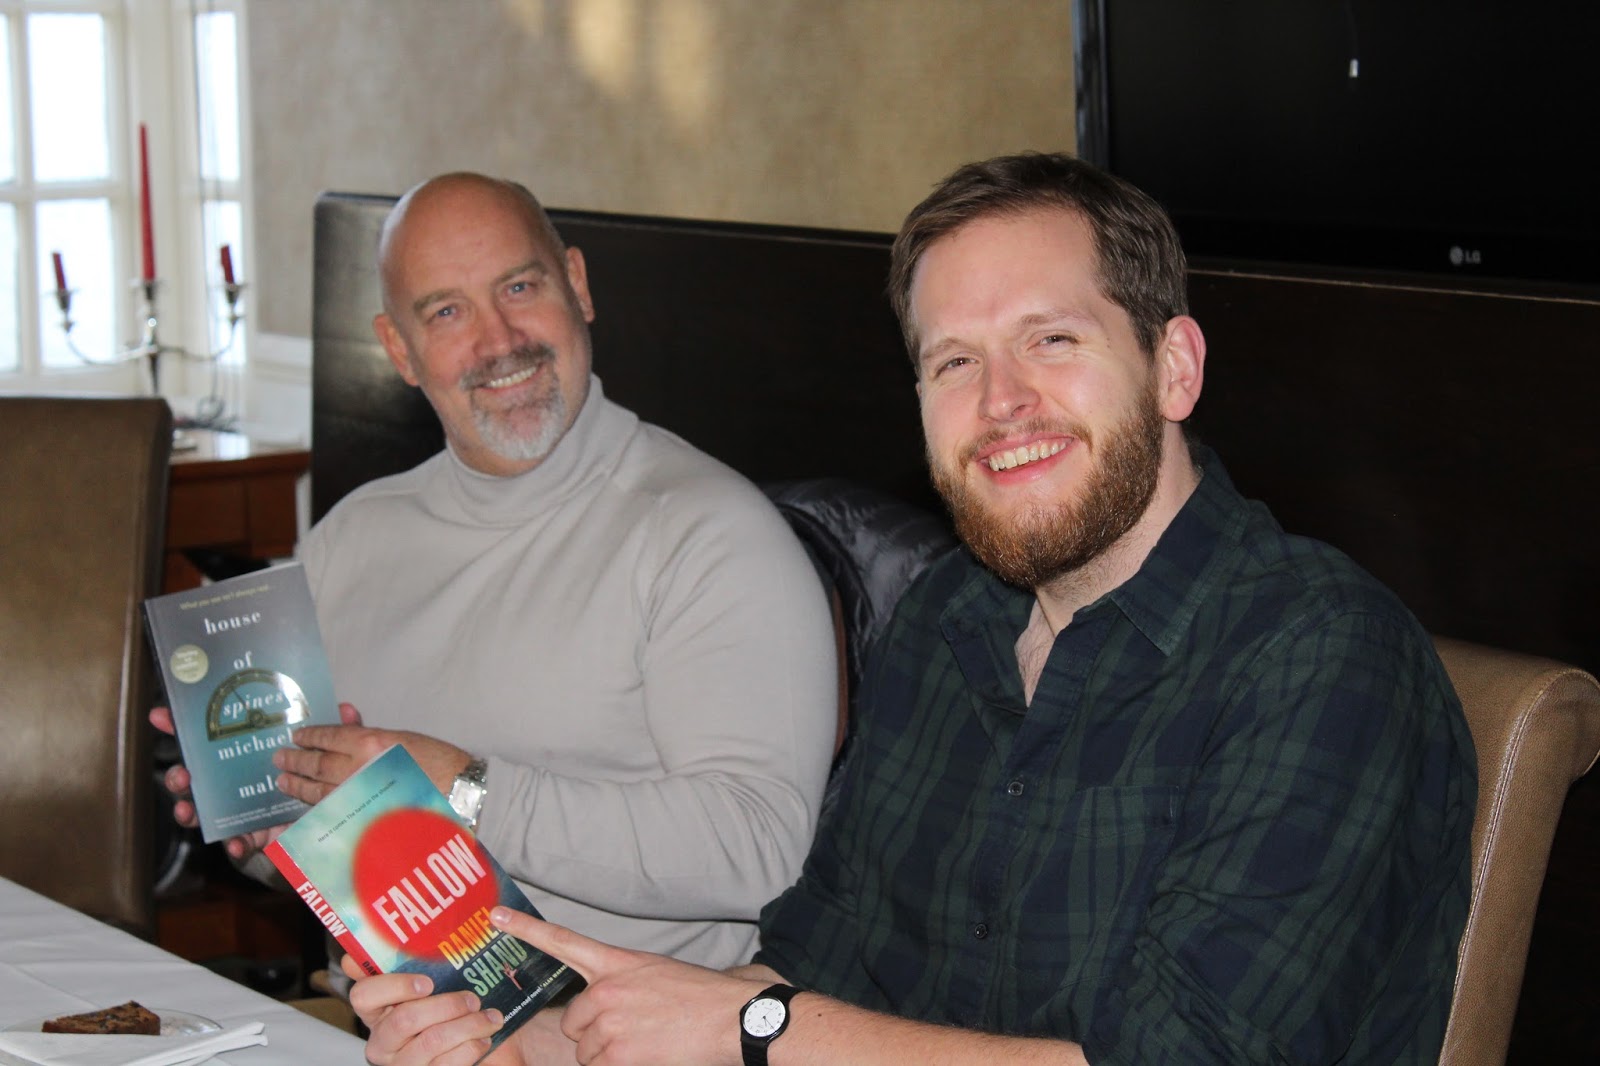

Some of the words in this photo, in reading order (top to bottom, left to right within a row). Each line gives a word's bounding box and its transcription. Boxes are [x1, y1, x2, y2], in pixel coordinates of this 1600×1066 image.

[204, 611, 261, 635] house
[233, 650, 252, 670] of
[223, 692, 284, 719] spines
[218, 727, 293, 760] michael
[239, 775, 278, 798] mal
[317, 832, 329, 842] Here
[346, 812, 355, 820] The
[355, 803, 366, 814] hand
[371, 793, 379, 801] the
[371, 834, 486, 944] FALLOW
[296, 881, 347, 938] FALLOW
[463, 934, 528, 996] SHAND
[521, 995, 532, 1007] road
[543, 977, 554, 987] ALAN
